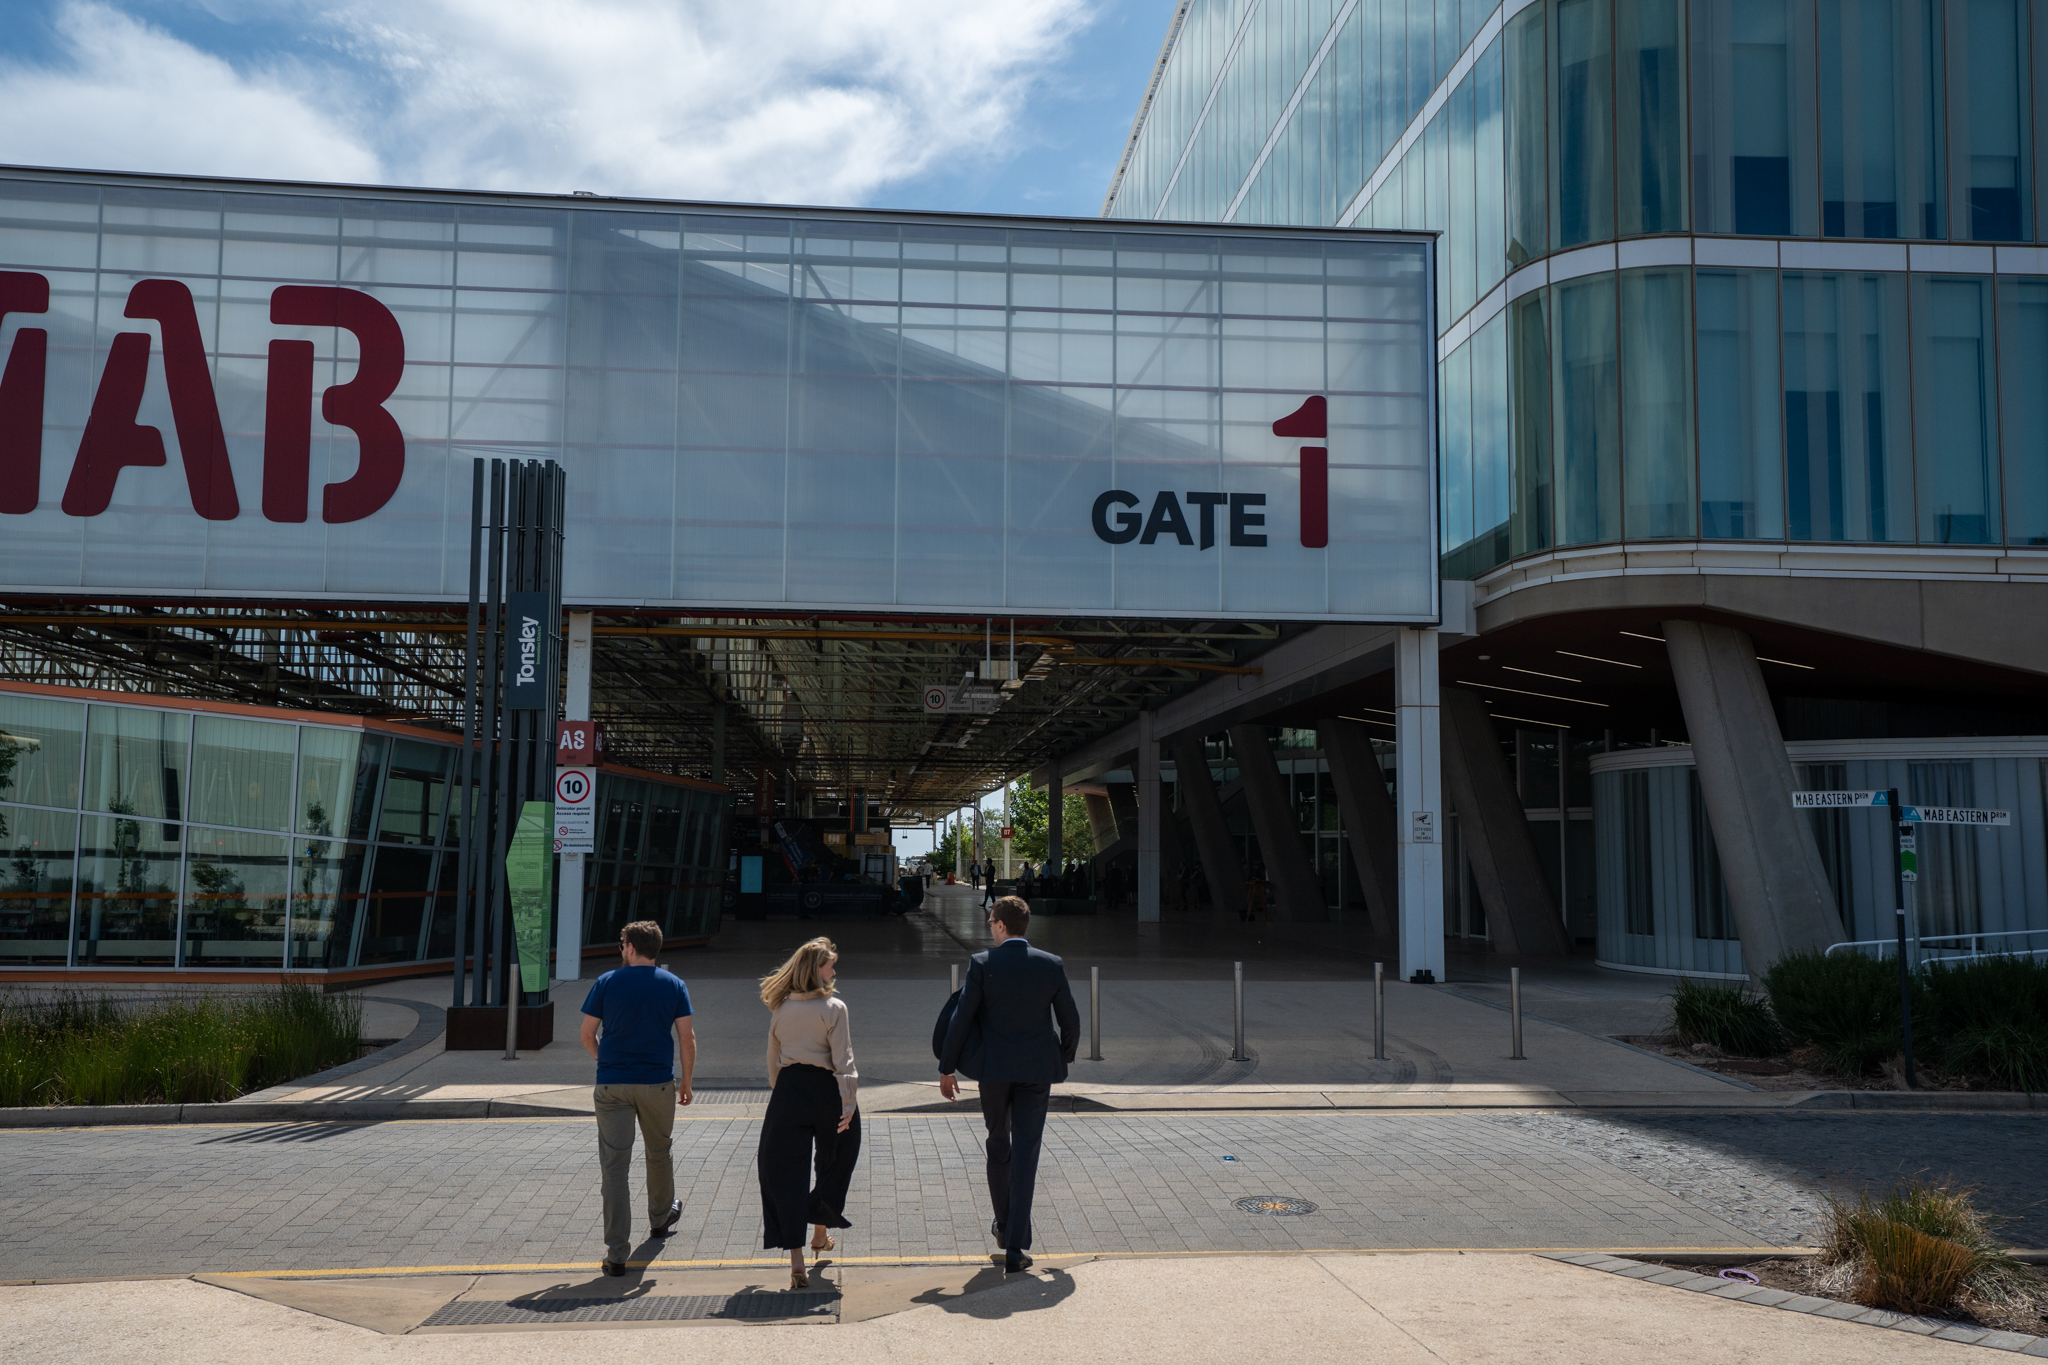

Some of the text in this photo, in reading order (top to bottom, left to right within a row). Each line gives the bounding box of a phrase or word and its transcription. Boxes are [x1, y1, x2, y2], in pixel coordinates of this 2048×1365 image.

[1091, 395, 1329, 552] GATE 1
[516, 616, 539, 687] Tonsley
[930, 694, 941, 704] 10
[564, 780, 583, 795] 10
[1795, 792, 1869, 806] MAB EASTERN PROM
[1924, 808, 2007, 823] MAB EASTERN PROM
